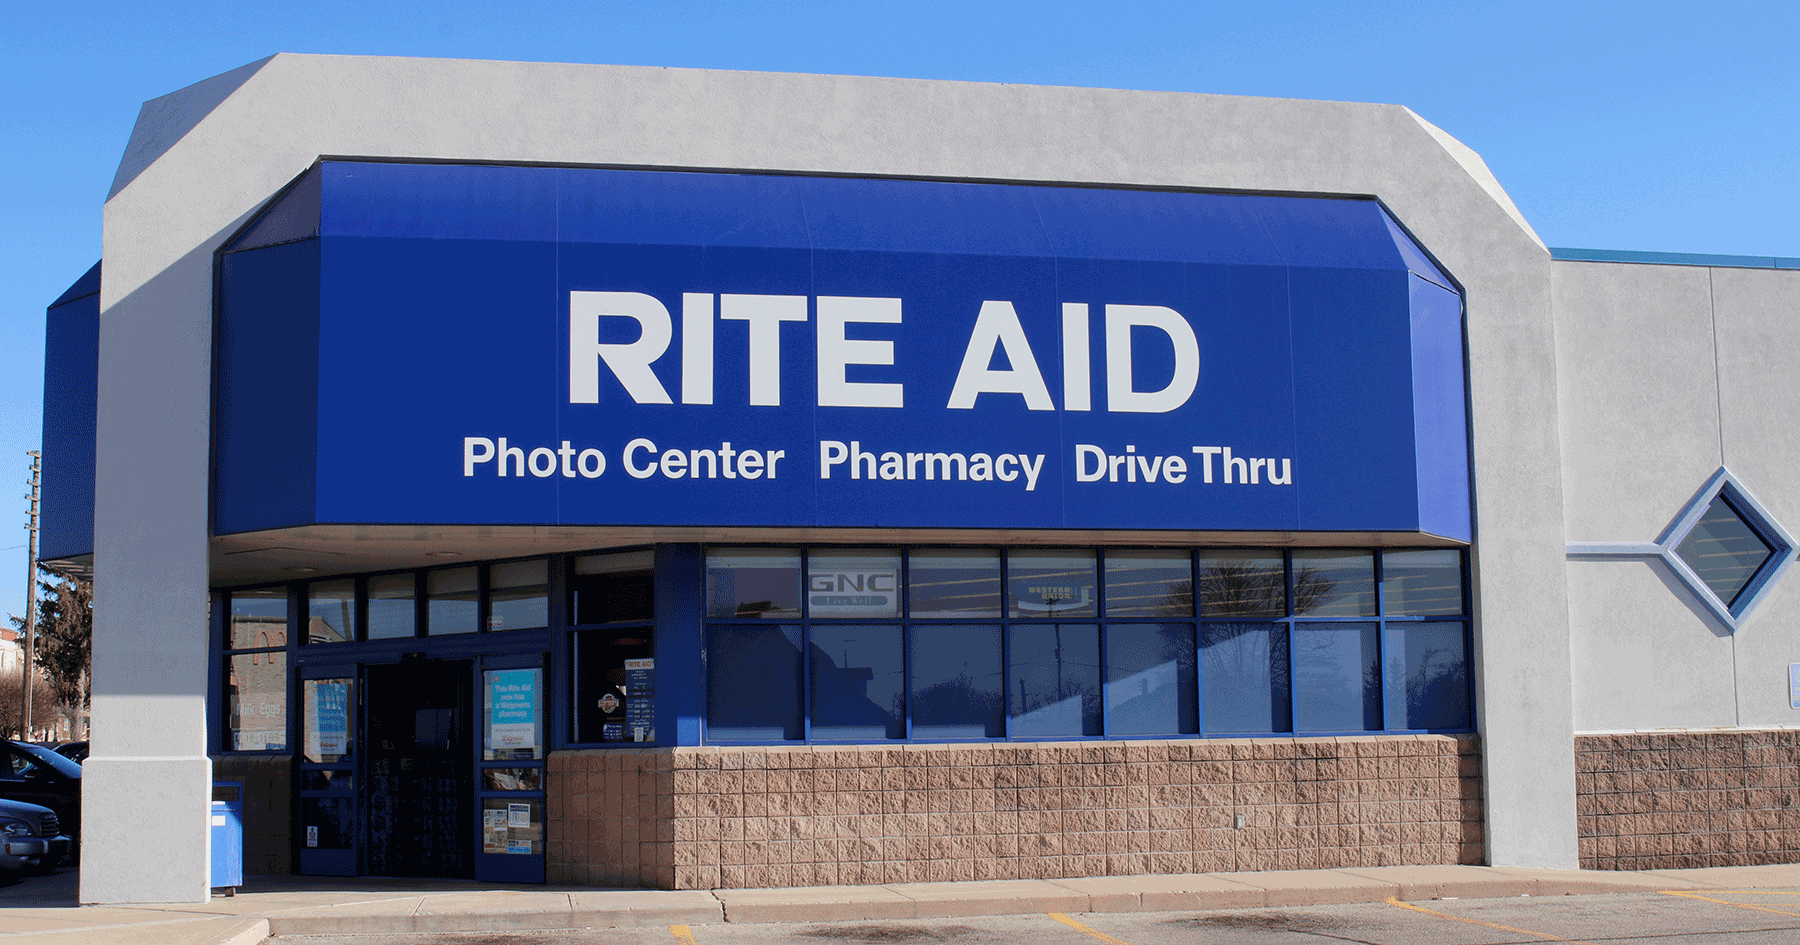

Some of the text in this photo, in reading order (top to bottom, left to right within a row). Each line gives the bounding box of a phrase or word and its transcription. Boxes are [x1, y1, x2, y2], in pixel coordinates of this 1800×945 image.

[569, 290, 1200, 414] RITE AID
[463, 436, 785, 480] Photo Center
[819, 440, 1046, 492] Pharmacy
[1075, 444, 1292, 486] Drive Thru
[808, 573, 894, 592] GNC
[826, 596, 848, 605] Live
[236, 701, 281, 718] Milk Eggs
